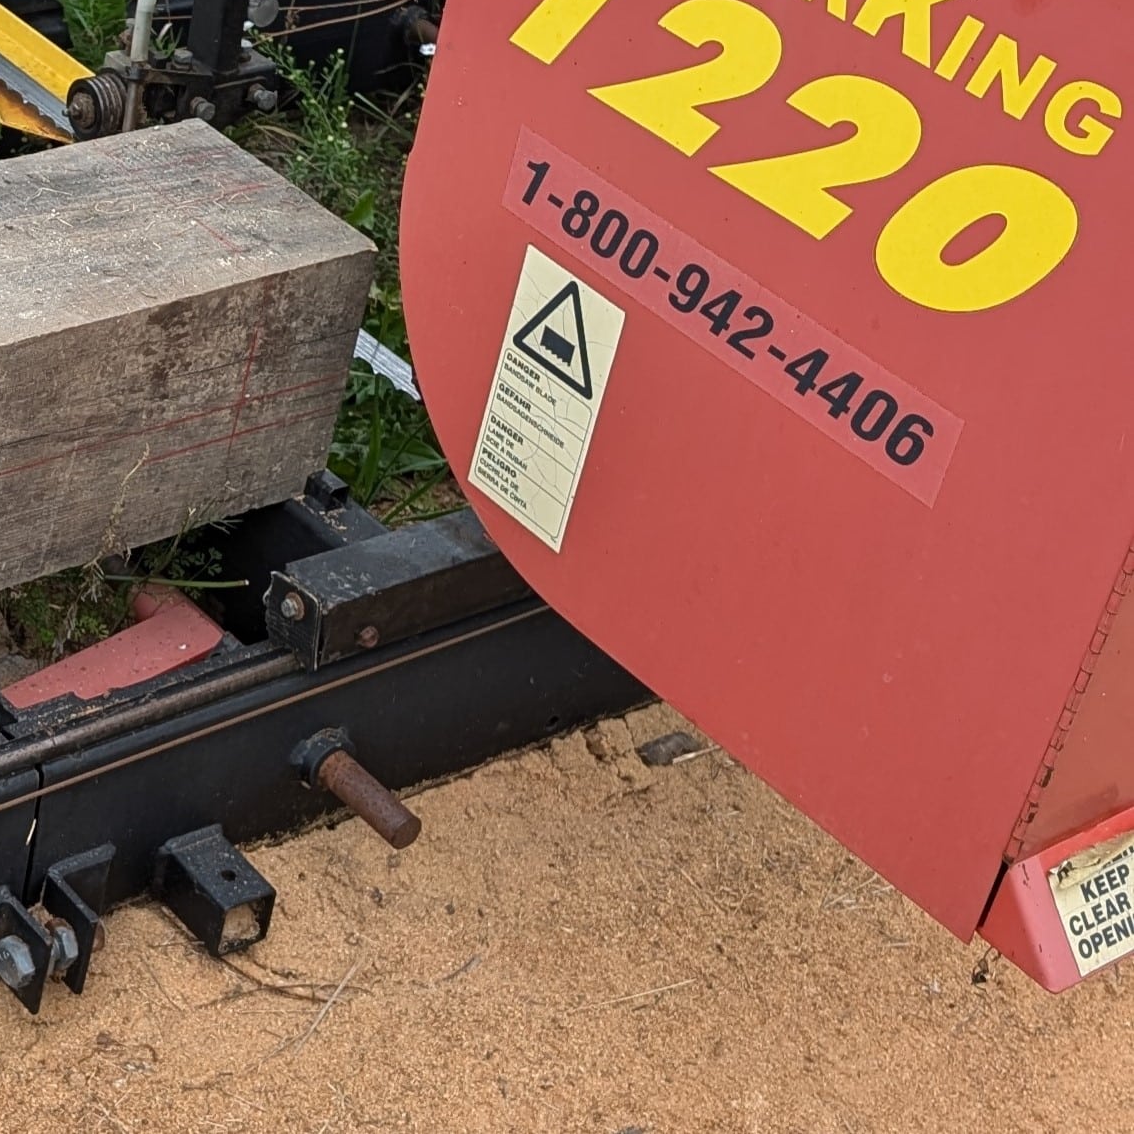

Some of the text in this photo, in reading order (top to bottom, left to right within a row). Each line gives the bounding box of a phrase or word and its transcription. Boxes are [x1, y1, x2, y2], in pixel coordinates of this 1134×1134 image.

[521, 160, 935, 467] 1-800-942-4406
[504, 363, 556, 406] BANDSAW BLADE
[506, 352, 540, 382] DANGER
[499, 383, 532, 412] GEFAHR
[490, 415, 523, 446] DANGER
[482, 447, 517, 478] PELIGRO
[1080, 863, 1130, 903] KEEP
[1069, 892, 1131, 936] CLEAR
[1078, 913, 1134, 959] OPENI
